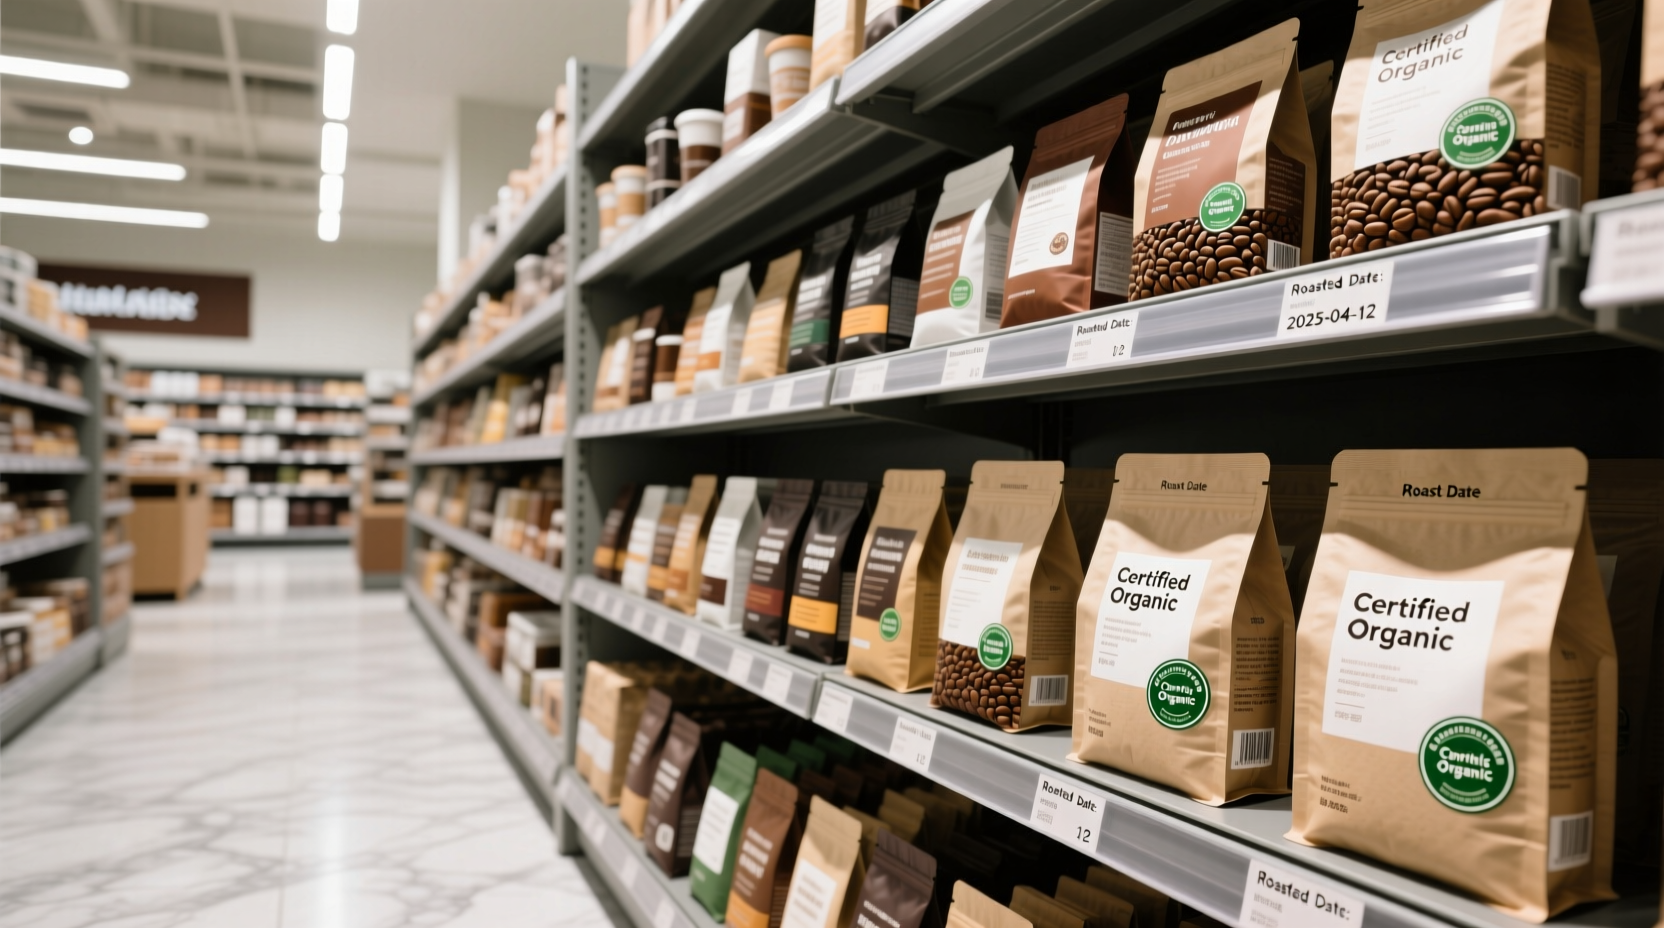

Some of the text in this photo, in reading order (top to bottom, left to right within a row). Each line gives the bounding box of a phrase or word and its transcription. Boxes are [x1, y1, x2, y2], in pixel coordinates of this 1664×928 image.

[1382, 24, 1468, 65] Certified
[1377, 48, 1464, 83] Organic
[1291, 271, 1383, 297] Roasted Date:
[1286, 303, 1376, 330] 2025-04-12
[1402, 483, 1481, 498] Roast Date
[1117, 566, 1191, 591] Certified
[1110, 586, 1178, 612] Organic
[1353, 592, 1470, 623] Certified
[1347, 618, 1454, 651] Organic
[1076, 826, 1091, 843] 12
